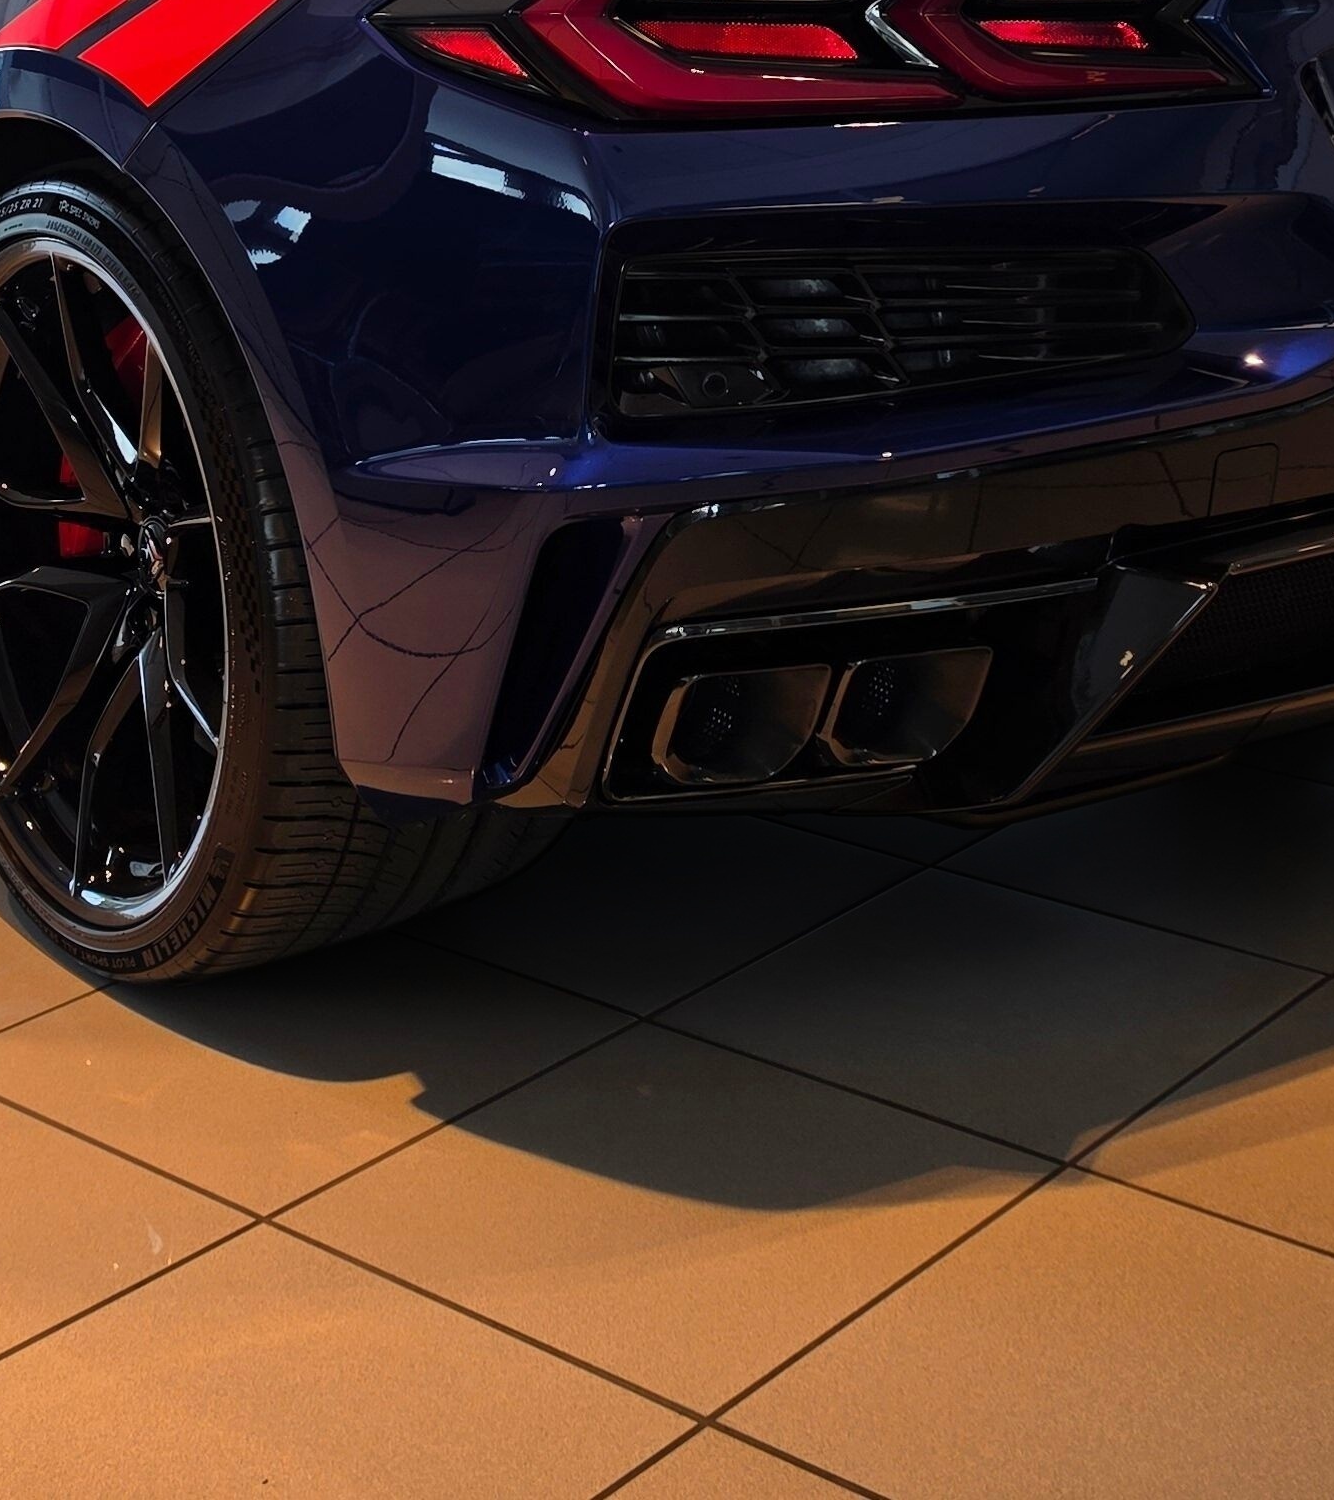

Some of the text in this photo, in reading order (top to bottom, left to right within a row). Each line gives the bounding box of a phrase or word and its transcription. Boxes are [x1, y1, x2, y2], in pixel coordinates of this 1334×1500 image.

[19, 198, 32, 211] ZR
[32, 197, 43, 209] 21
[141, 874, 220, 969] MICHELIN
